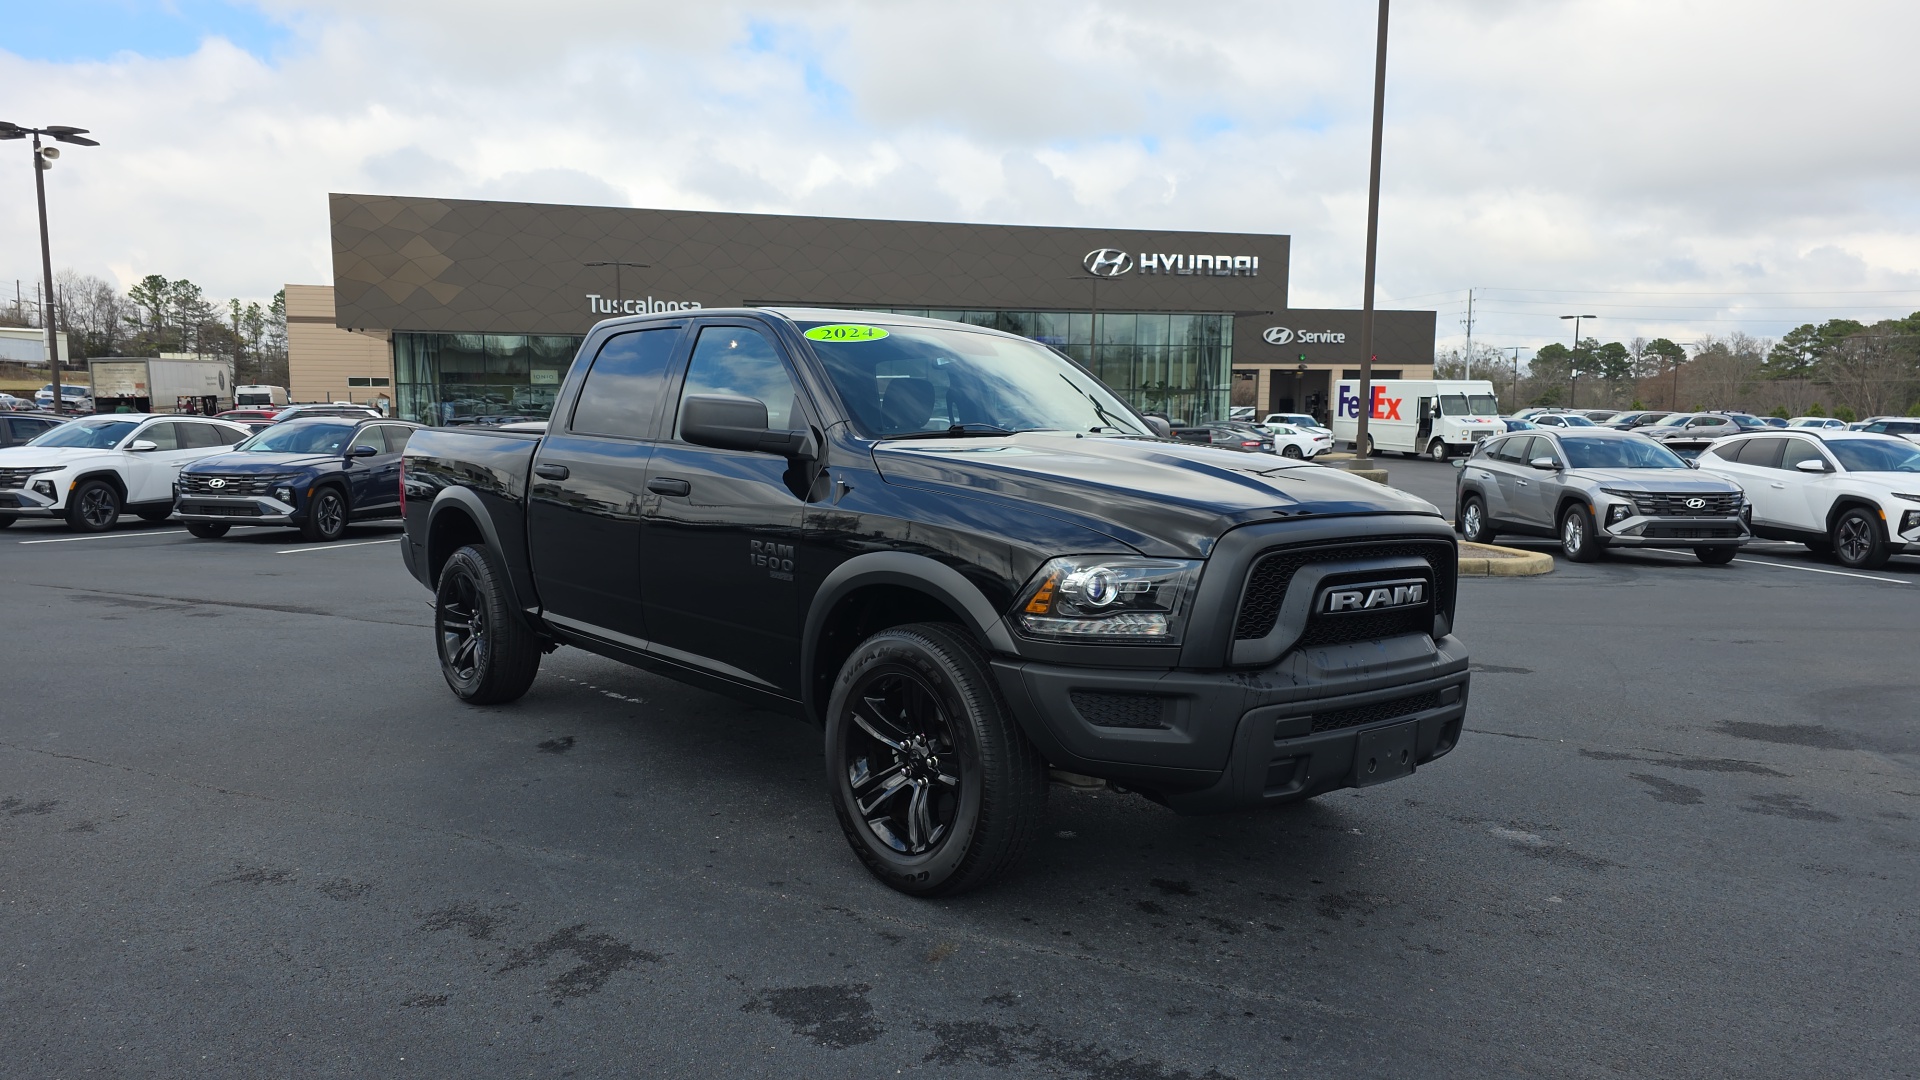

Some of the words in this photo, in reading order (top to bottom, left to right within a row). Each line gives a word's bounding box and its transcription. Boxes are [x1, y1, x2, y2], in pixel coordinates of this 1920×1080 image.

[1139, 253, 1259, 276] HYUNDAI
[820, 327, 874, 340] 2024
[1297, 329, 1346, 344] Service
[750, 539, 795, 559] RAM
[750, 553, 795, 572] 1500
[1330, 584, 1423, 612] RAM
[843, 646, 942, 685] WRANGLER
